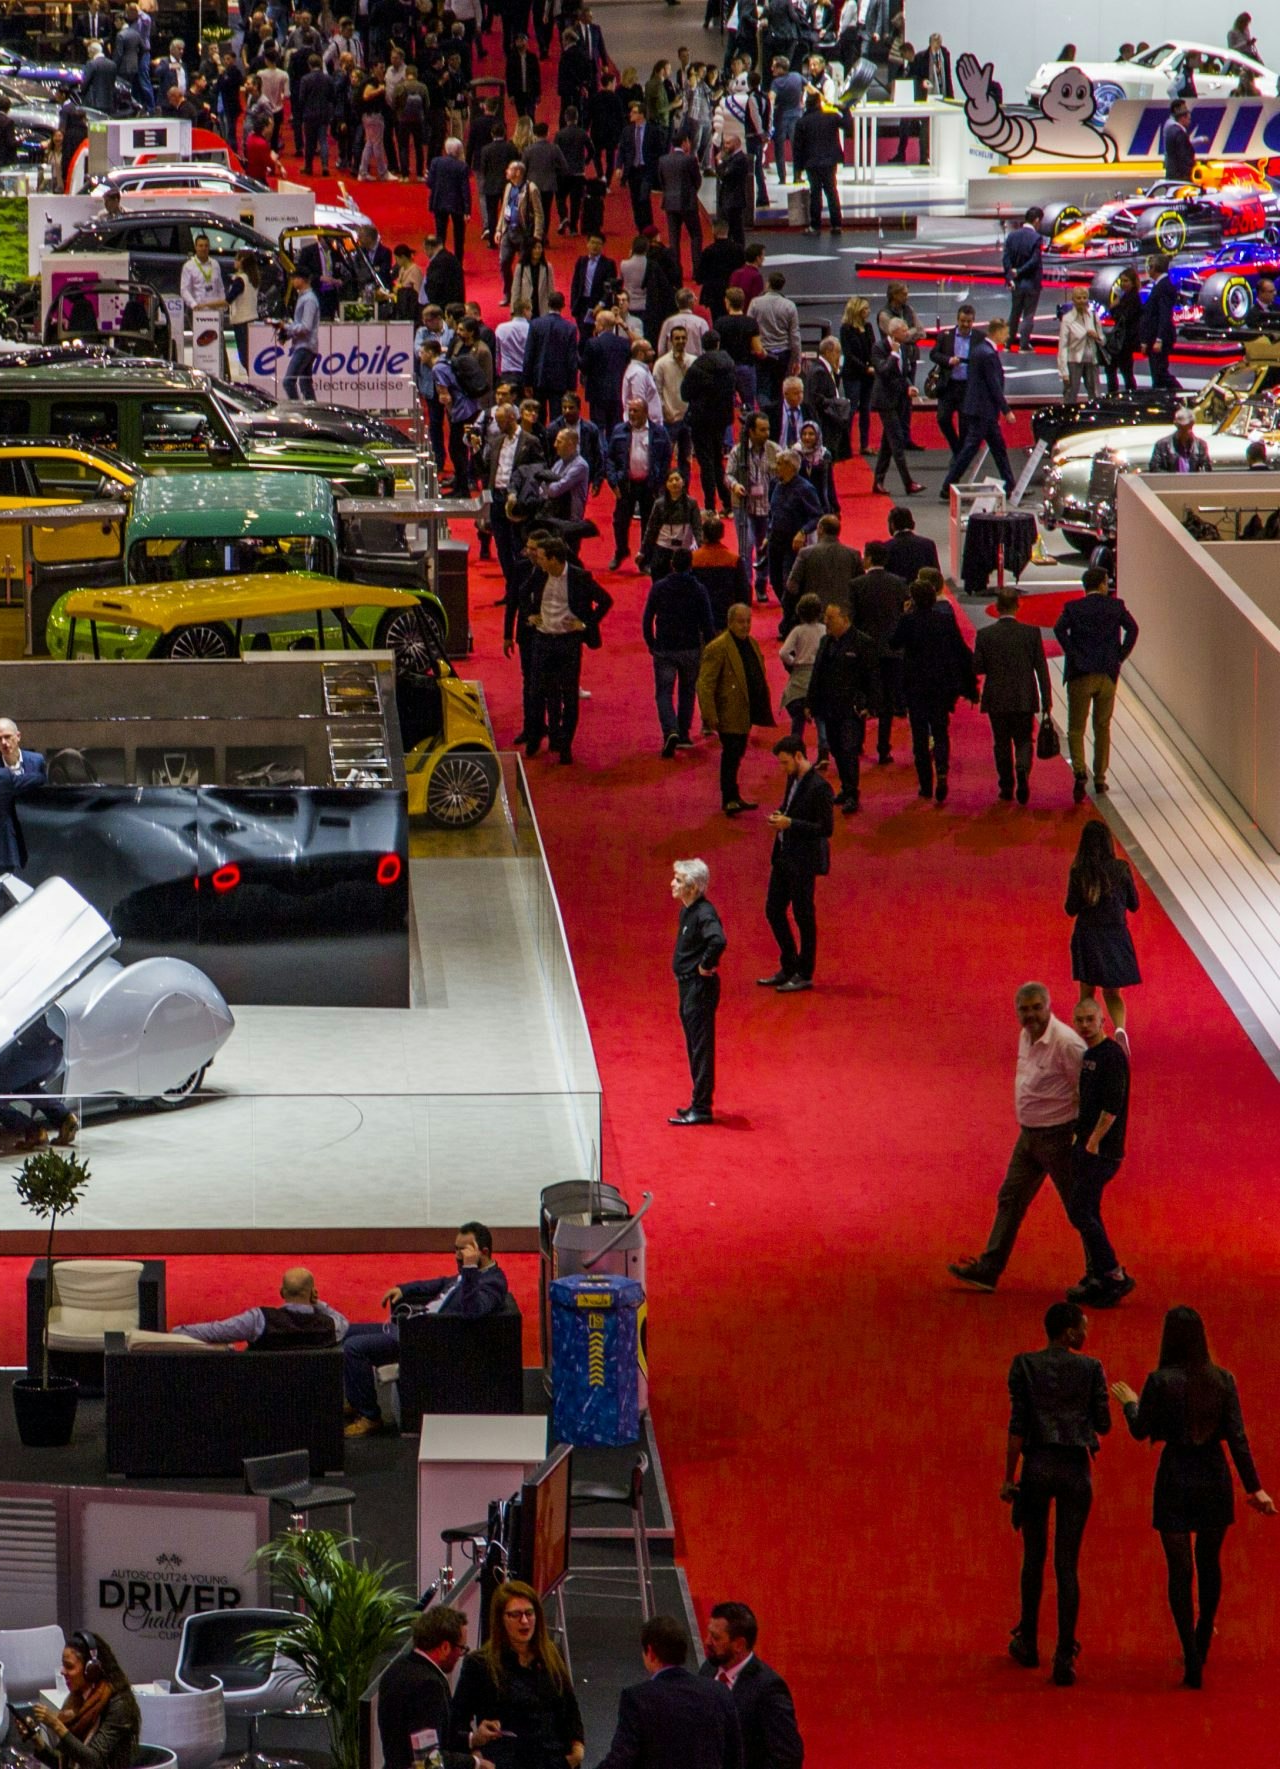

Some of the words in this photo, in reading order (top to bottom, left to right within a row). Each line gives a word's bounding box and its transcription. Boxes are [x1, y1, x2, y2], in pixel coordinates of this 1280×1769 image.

[253, 345, 409, 375] e'obile
[111, 1569, 188, 1583] AUTOSCOUT24
[191, 1575, 228, 1585] YOUNG
[99, 1579, 241, 1614] DRIVER
